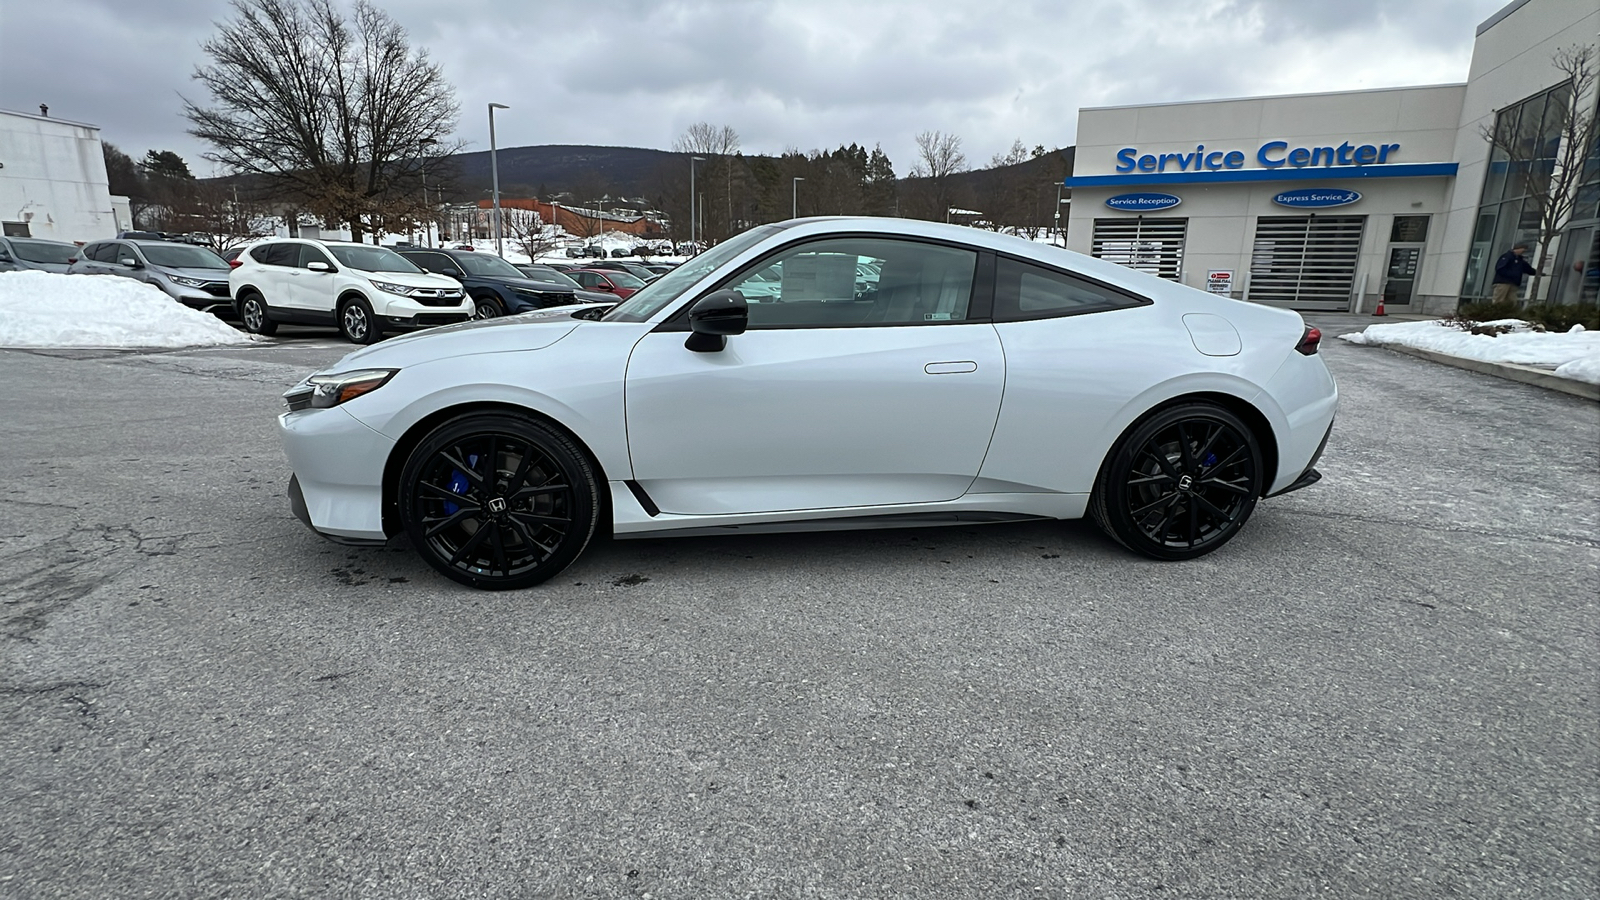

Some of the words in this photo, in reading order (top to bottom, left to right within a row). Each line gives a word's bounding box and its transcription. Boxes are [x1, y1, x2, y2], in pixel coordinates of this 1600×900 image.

[1116, 145, 1245, 173] Service
[1257, 141, 1400, 167] Center
[1138, 197, 1176, 206] Reception
[1277, 195, 1309, 203] Express
